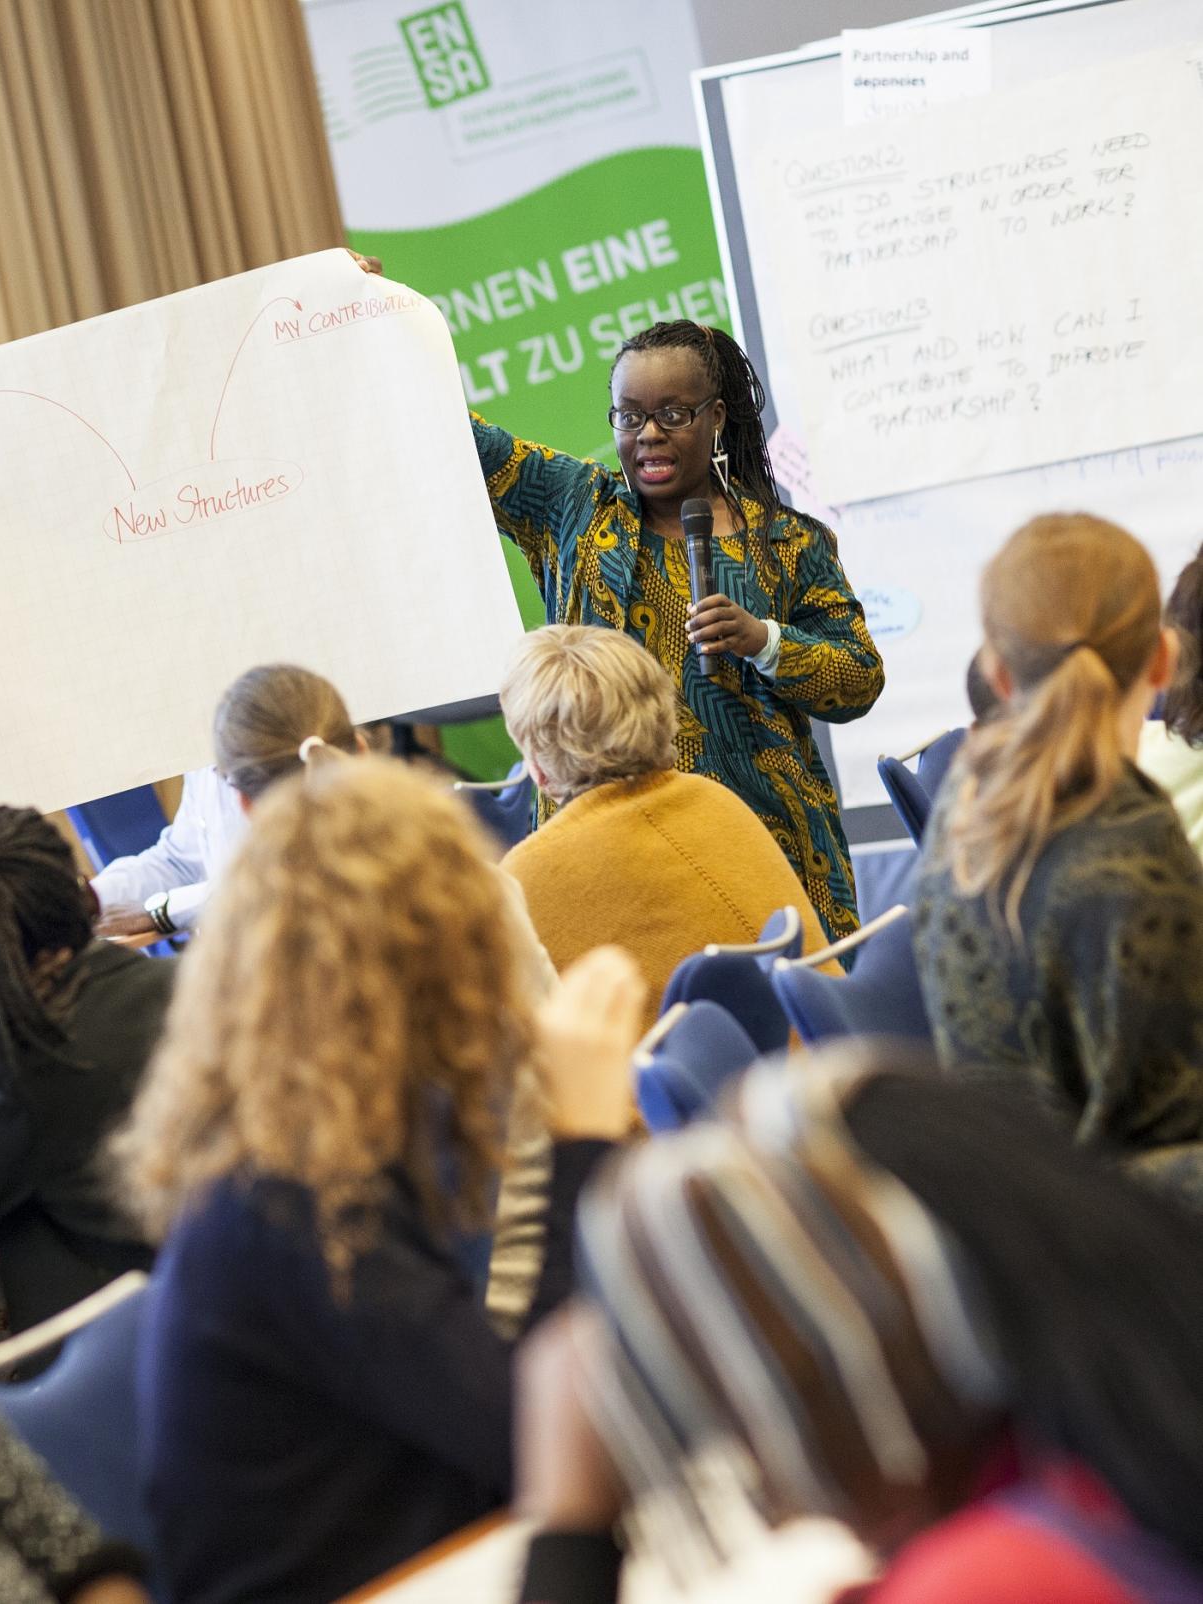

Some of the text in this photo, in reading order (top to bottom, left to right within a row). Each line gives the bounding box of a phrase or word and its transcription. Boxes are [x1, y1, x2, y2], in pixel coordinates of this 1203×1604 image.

[853, 47, 970, 63] Partnership and
[810, 162, 1136, 244] TO CHANGE IN ORDER FOR
[853, 191, 892, 214] DO
[910, 147, 1068, 201] STRUCTURES
[1091, 131, 1151, 158] NEED
[561, 218, 680, 295] EINE
[999, 215, 1028, 237] TO
[274, 319, 302, 341] MY
[517, 325, 586, 385] ZU
[829, 297, 1144, 382] WHAT AND HOW CAN I
[843, 339, 1147, 413] CONTRIBUTE TO IMPROVE
[113, 474, 291, 545] New Structures
